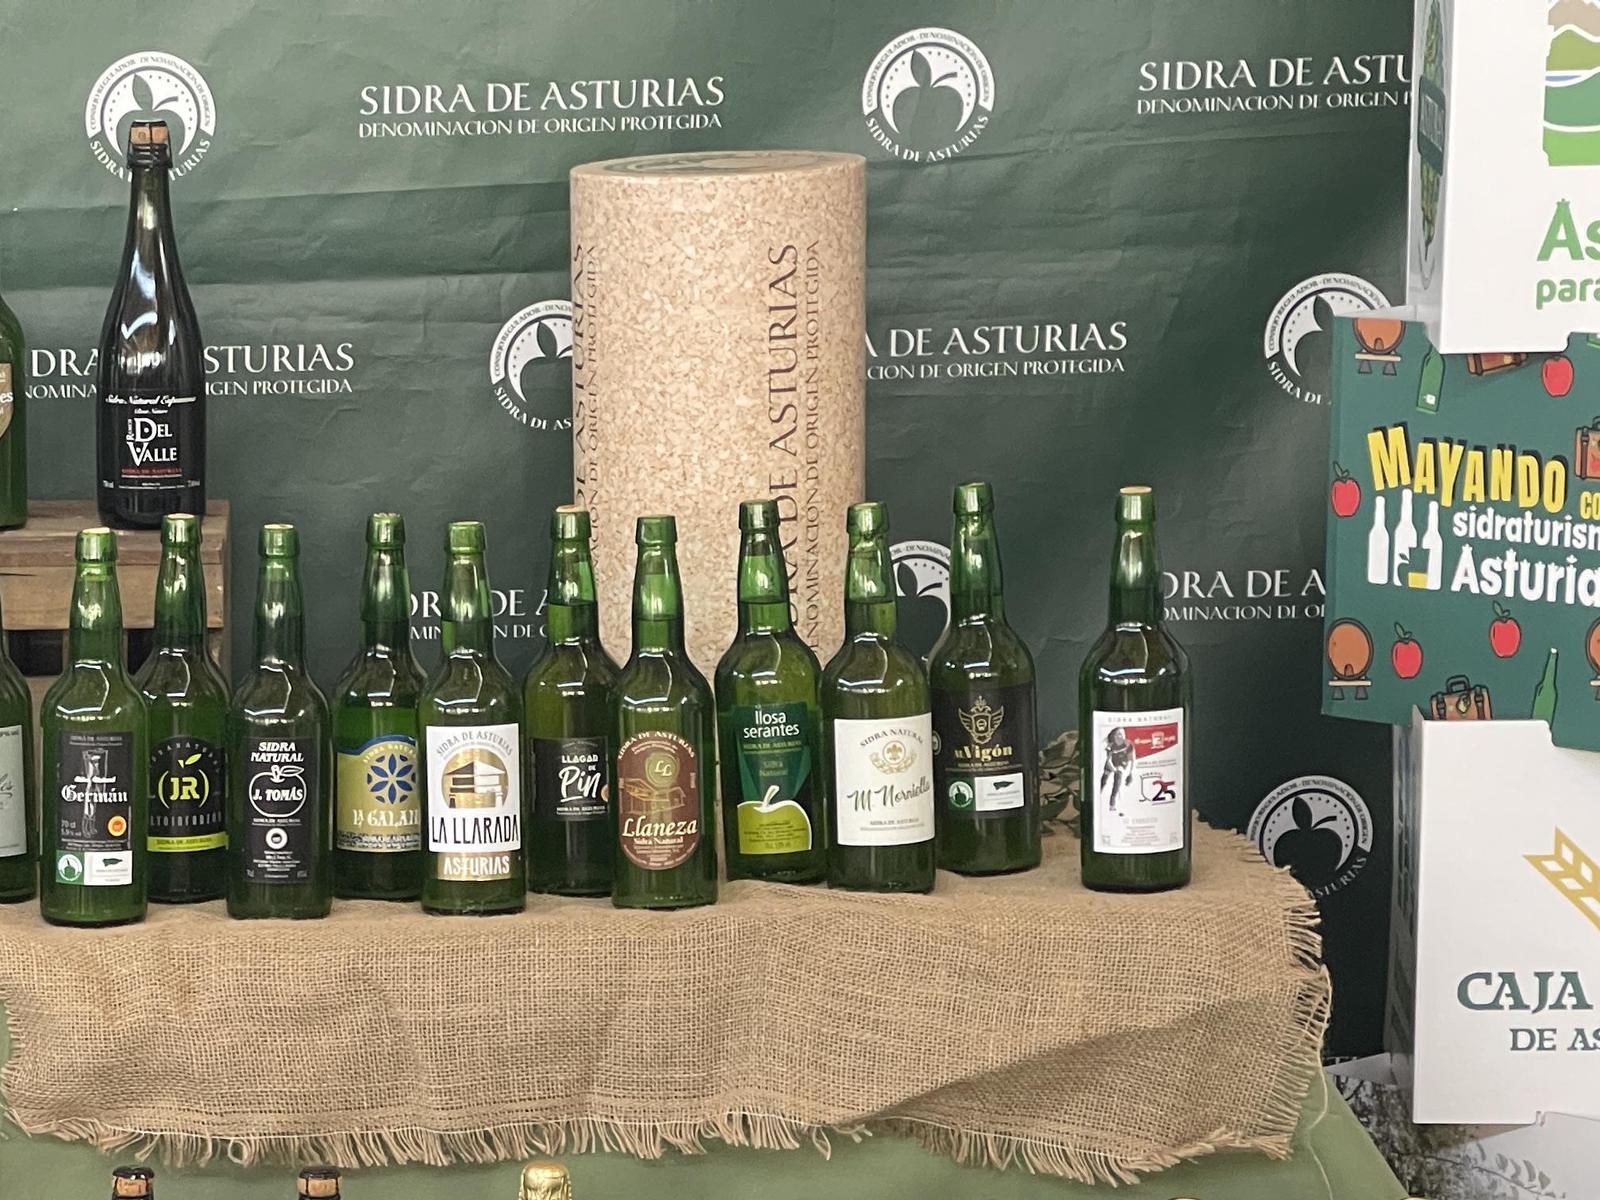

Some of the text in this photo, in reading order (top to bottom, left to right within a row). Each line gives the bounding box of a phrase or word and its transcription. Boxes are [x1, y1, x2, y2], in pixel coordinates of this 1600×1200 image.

[1138, 60, 1257, 92] SIDRA
[1269, 57, 1313, 88] DE
[360, 75, 725, 117] SIDRA DE ASTURIAS
[358, 112, 723, 139] DENOMINACION DE ORIGEN PROTEGIDA
[806, 239, 821, 360] PROTEGIDA
[767, 243, 798, 457] ASTURIAS
[889, 321, 1128, 358] DE ASTURIAS
[921, 358, 1125, 381] DE ORIGEN PROTEGIDA
[134, 417, 172, 441] DEL
[126, 440, 178, 467] VALLE
[1367, 424, 1568, 514] MAYANDO
[1450, 545, 1600, 608] Asturia
[755, 709, 787, 726] llosa
[436, 733, 459, 756] SIDRA
[474, 729, 514, 756] ASTURIAS
[743, 722, 800, 739] serantes
[251, 751, 304, 764] NATURAL
[258, 741, 296, 753] SIDRA
[965, 745, 1012, 763] Vigón
[61, 784, 129, 804] Germán
[169, 776, 200, 800] JR
[264, 786, 304, 801] TOMÁS
[1152, 778, 1177, 801] 25
[431, 815, 447, 845] LA
[452, 813, 520, 845] LLARADA
[621, 816, 699, 838] Llaneza
[443, 855, 511, 877] ASTURIAS
[1457, 971, 1594, 1014] CAJA
[1510, 1027, 1557, 1051] DE
